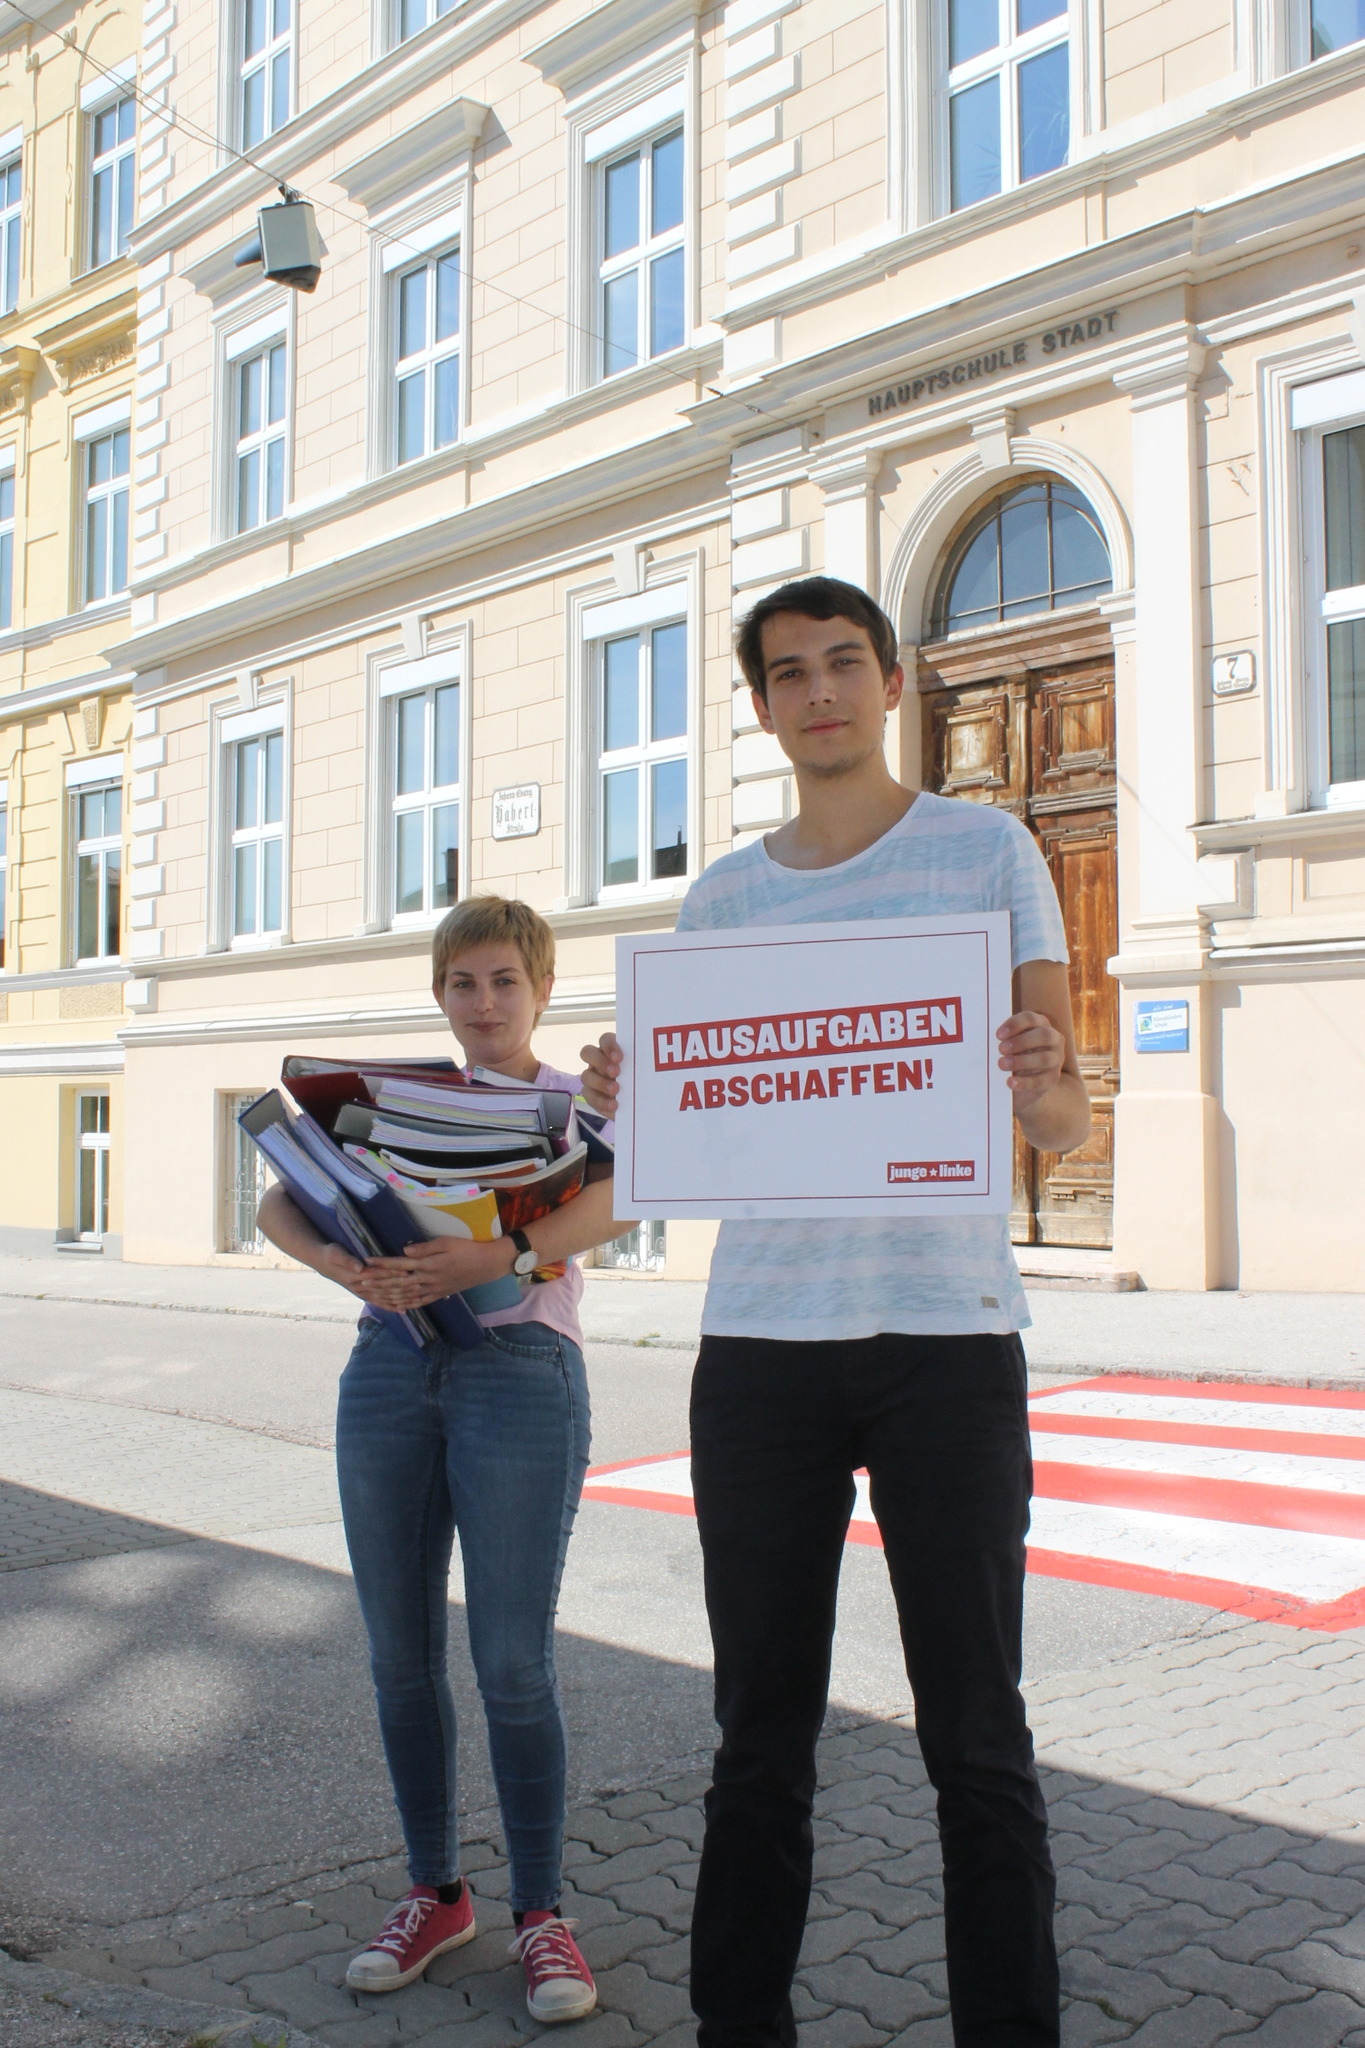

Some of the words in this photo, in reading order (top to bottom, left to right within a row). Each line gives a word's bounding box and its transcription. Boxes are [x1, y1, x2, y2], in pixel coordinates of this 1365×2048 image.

[868, 342, 1027, 416] HAUPTSCHULE
[1041, 310, 1119, 354] STADT
[1227, 656, 1238, 679] 7
[657, 1004, 957, 1064] HAUSAUFGABEN
[679, 1058, 933, 1111] ABSCHAFFEN!
[889, 1164, 927, 1181] junge
[938, 1162, 972, 1177] linke
